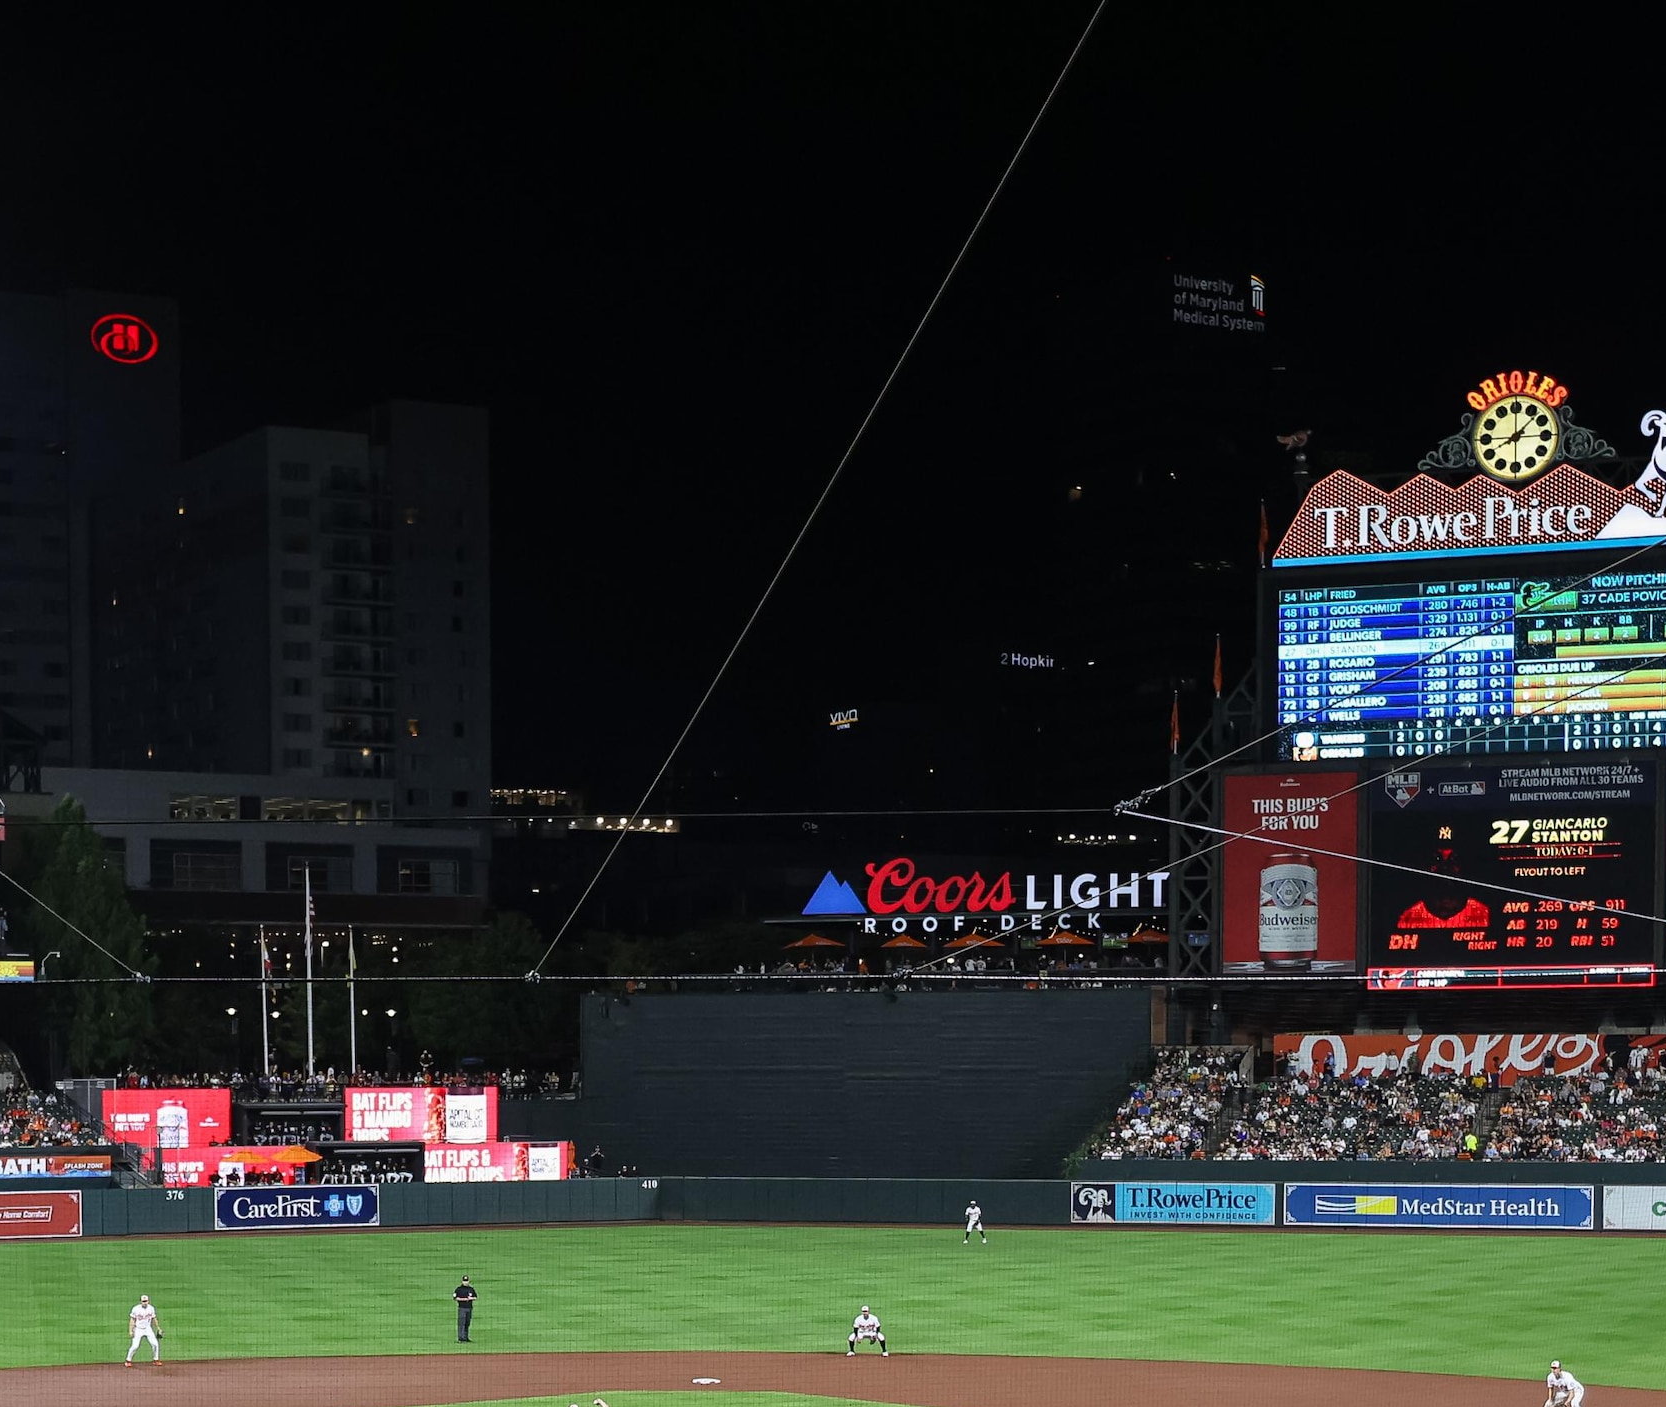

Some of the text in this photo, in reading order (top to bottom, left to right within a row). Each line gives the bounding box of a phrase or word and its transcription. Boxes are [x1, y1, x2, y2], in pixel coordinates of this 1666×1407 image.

[1174, 274, 1234, 296] University
[1174, 292, 1244, 312] of Maryland
[1174, 309, 1265, 333] Medical System
[1467, 371, 1569, 411] ORIOLES
[1592, 575, 1623, 588] NOW
[1330, 590, 1356, 599] FRIED
[1582, 594, 1596, 604] 37
[1598, 592, 1630, 603] CADE
[1330, 603, 1402, 616] GOLDSCHMIDT
[1329, 619, 1361, 630] JUDGE
[1329, 631, 1381, 643] BELLINGER
[1501, 766, 1609, 779] STREAM MLB NETWORK
[1252, 798, 1328, 814] THIS BUD'S
[1261, 815, 1319, 831] FOR YOU
[1489, 817, 1607, 844] 27 GIANCARLO
[1532, 830, 1603, 843] STANTON
[1515, 866, 1586, 877] FLYOUT TO LEFT
[865, 857, 1170, 915] Coors LIGHT
[1503, 901, 1563, 913] AVG .269
[864, 913, 1102, 933] ROOF DECK
[641, 1179, 658, 1190] 410
[166, 1191, 184, 1200] 376
[1400, 1197, 1561, 1218] MedStar Health
[1130, 1211, 1164, 1219] INVEST
[1195, 1212, 1257, 1220] CONFIDENCE
